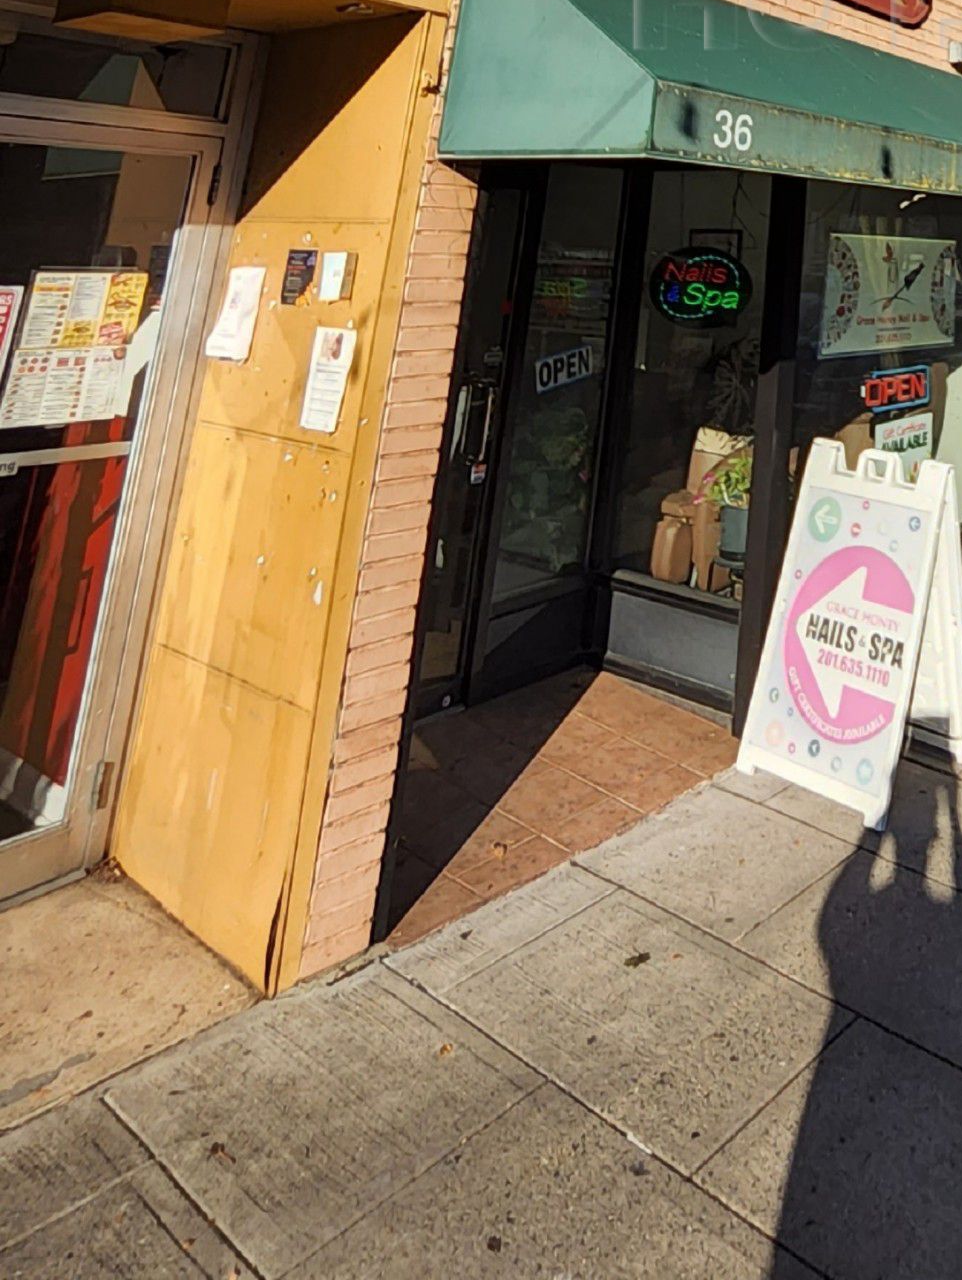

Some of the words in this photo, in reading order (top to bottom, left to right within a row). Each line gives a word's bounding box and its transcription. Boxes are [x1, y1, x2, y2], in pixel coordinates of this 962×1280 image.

[713, 109, 753, 151] 36
[664, 262, 728, 284] Nails
[683, 282, 739, 312] Spa
[538, 345, 591, 388] OPEN
[865, 372, 926, 408] OPEN
[805, 613, 858, 652] NAILS
[868, 632, 905, 669] SPA
[817, 648, 891, 688] 201.635.1110
